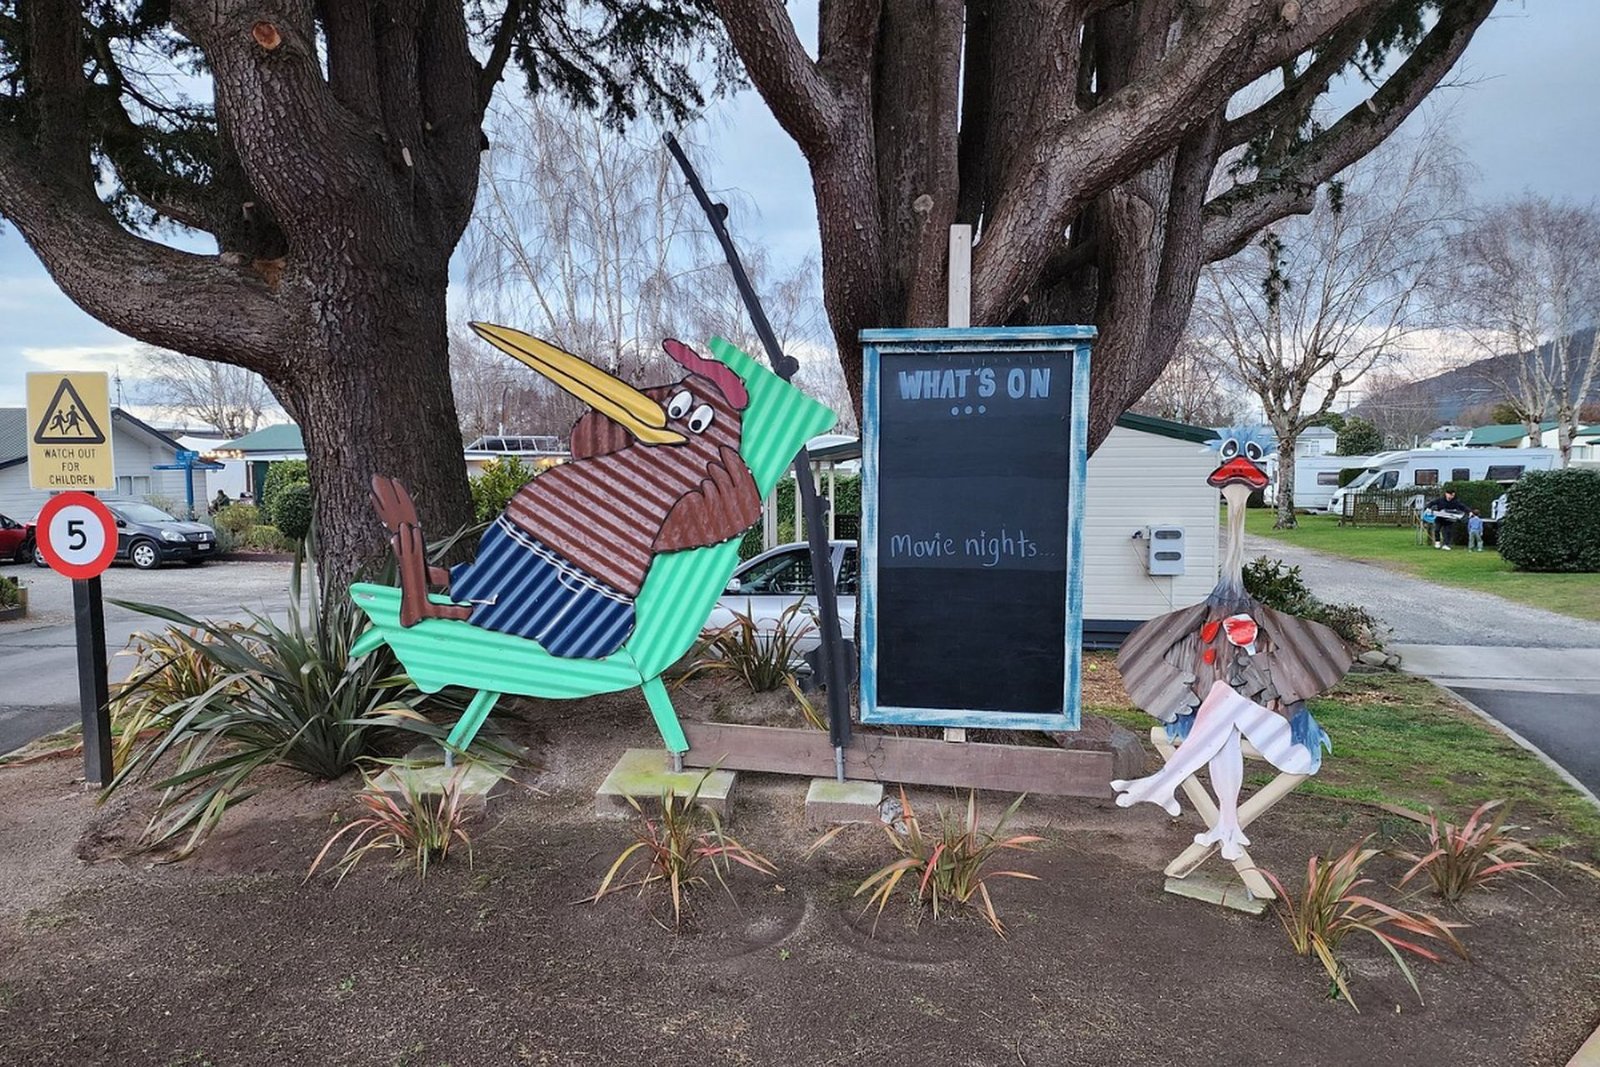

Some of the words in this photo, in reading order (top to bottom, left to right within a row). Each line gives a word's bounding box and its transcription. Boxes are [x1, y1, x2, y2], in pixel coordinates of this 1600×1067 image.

[898, 367, 997, 400] WHAT'S
[1007, 367, 1052, 399] ON
[44, 448, 75, 459] WATCH
[78, 448, 96, 459] OUT
[61, 462, 80, 472] FOR
[49, 474, 96, 485] CHILDREN
[67, 520, 87, 550] 5
[890, 532, 957, 558] Movie
